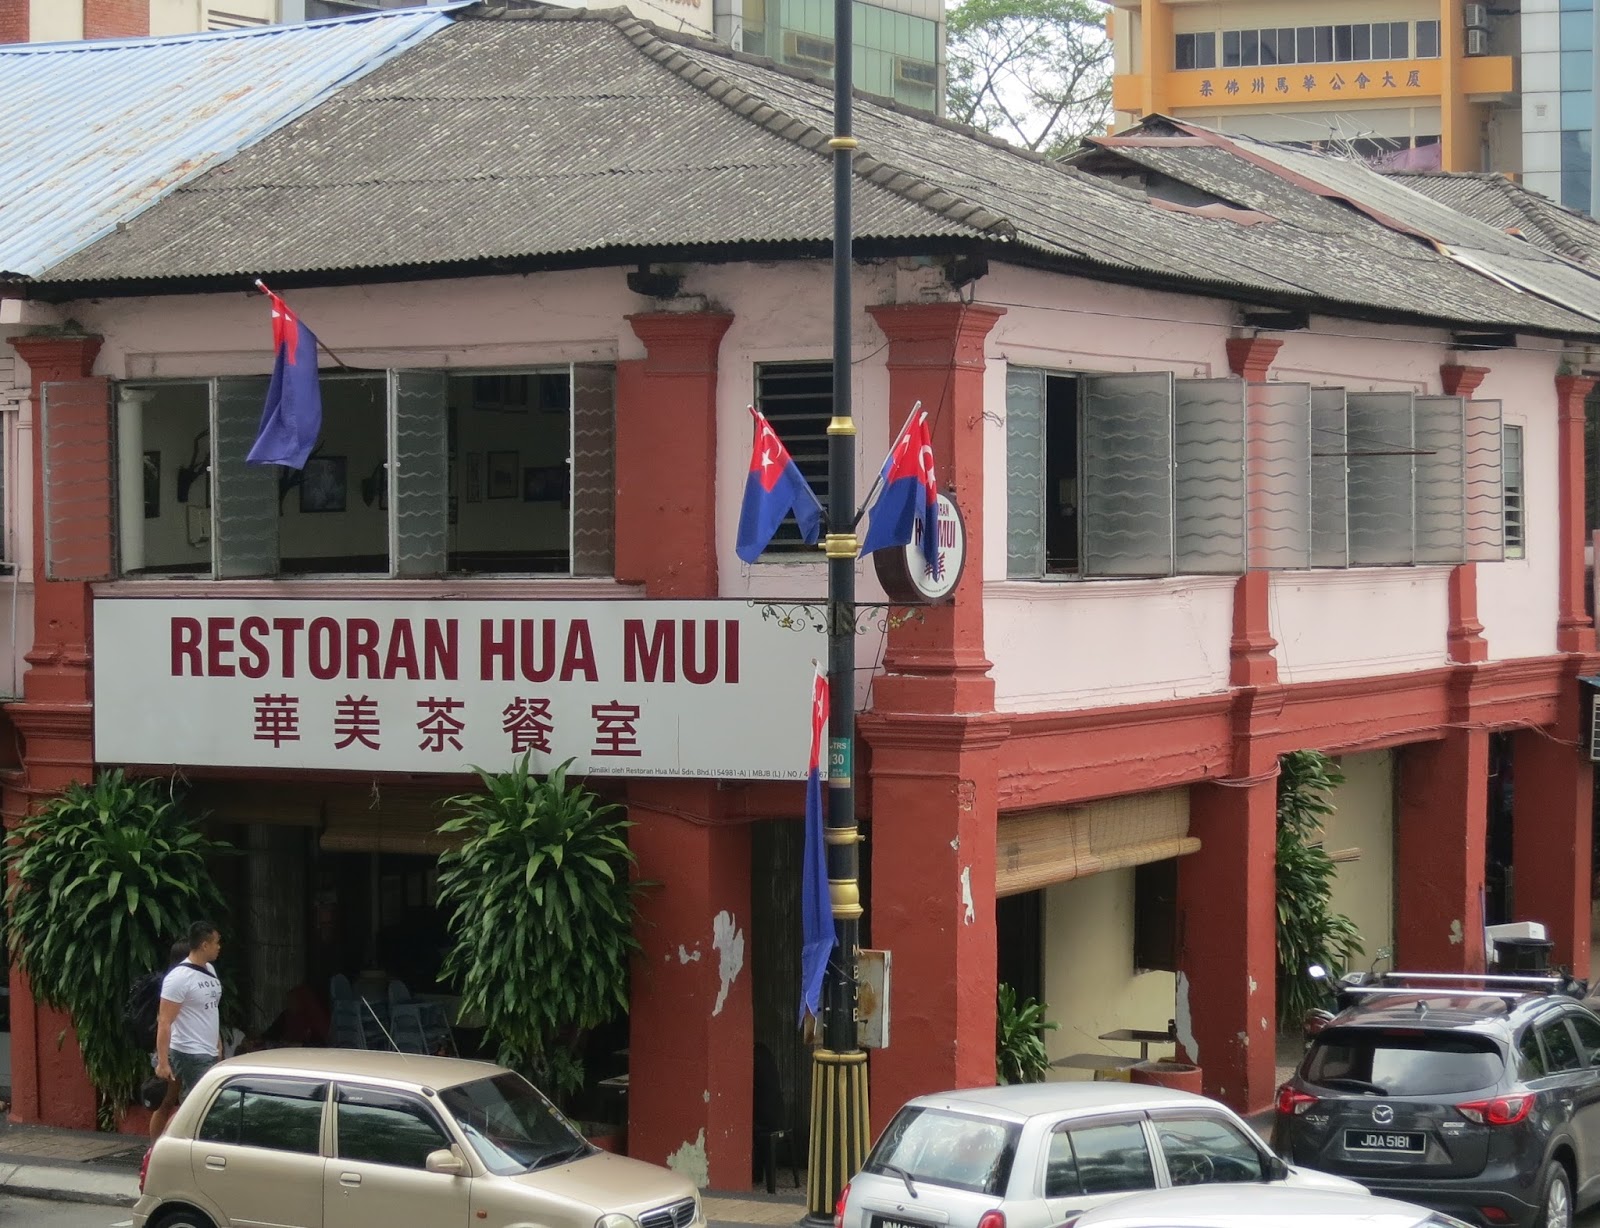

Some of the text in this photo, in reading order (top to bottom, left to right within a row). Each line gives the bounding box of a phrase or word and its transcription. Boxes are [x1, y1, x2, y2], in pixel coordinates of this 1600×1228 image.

[170, 616, 740, 684] RESTORAN HUA MUI
[832, 753, 845, 765] 30
[625, 767, 653, 775] Restoran
[1386, 1135, 1409, 1148] 5181
